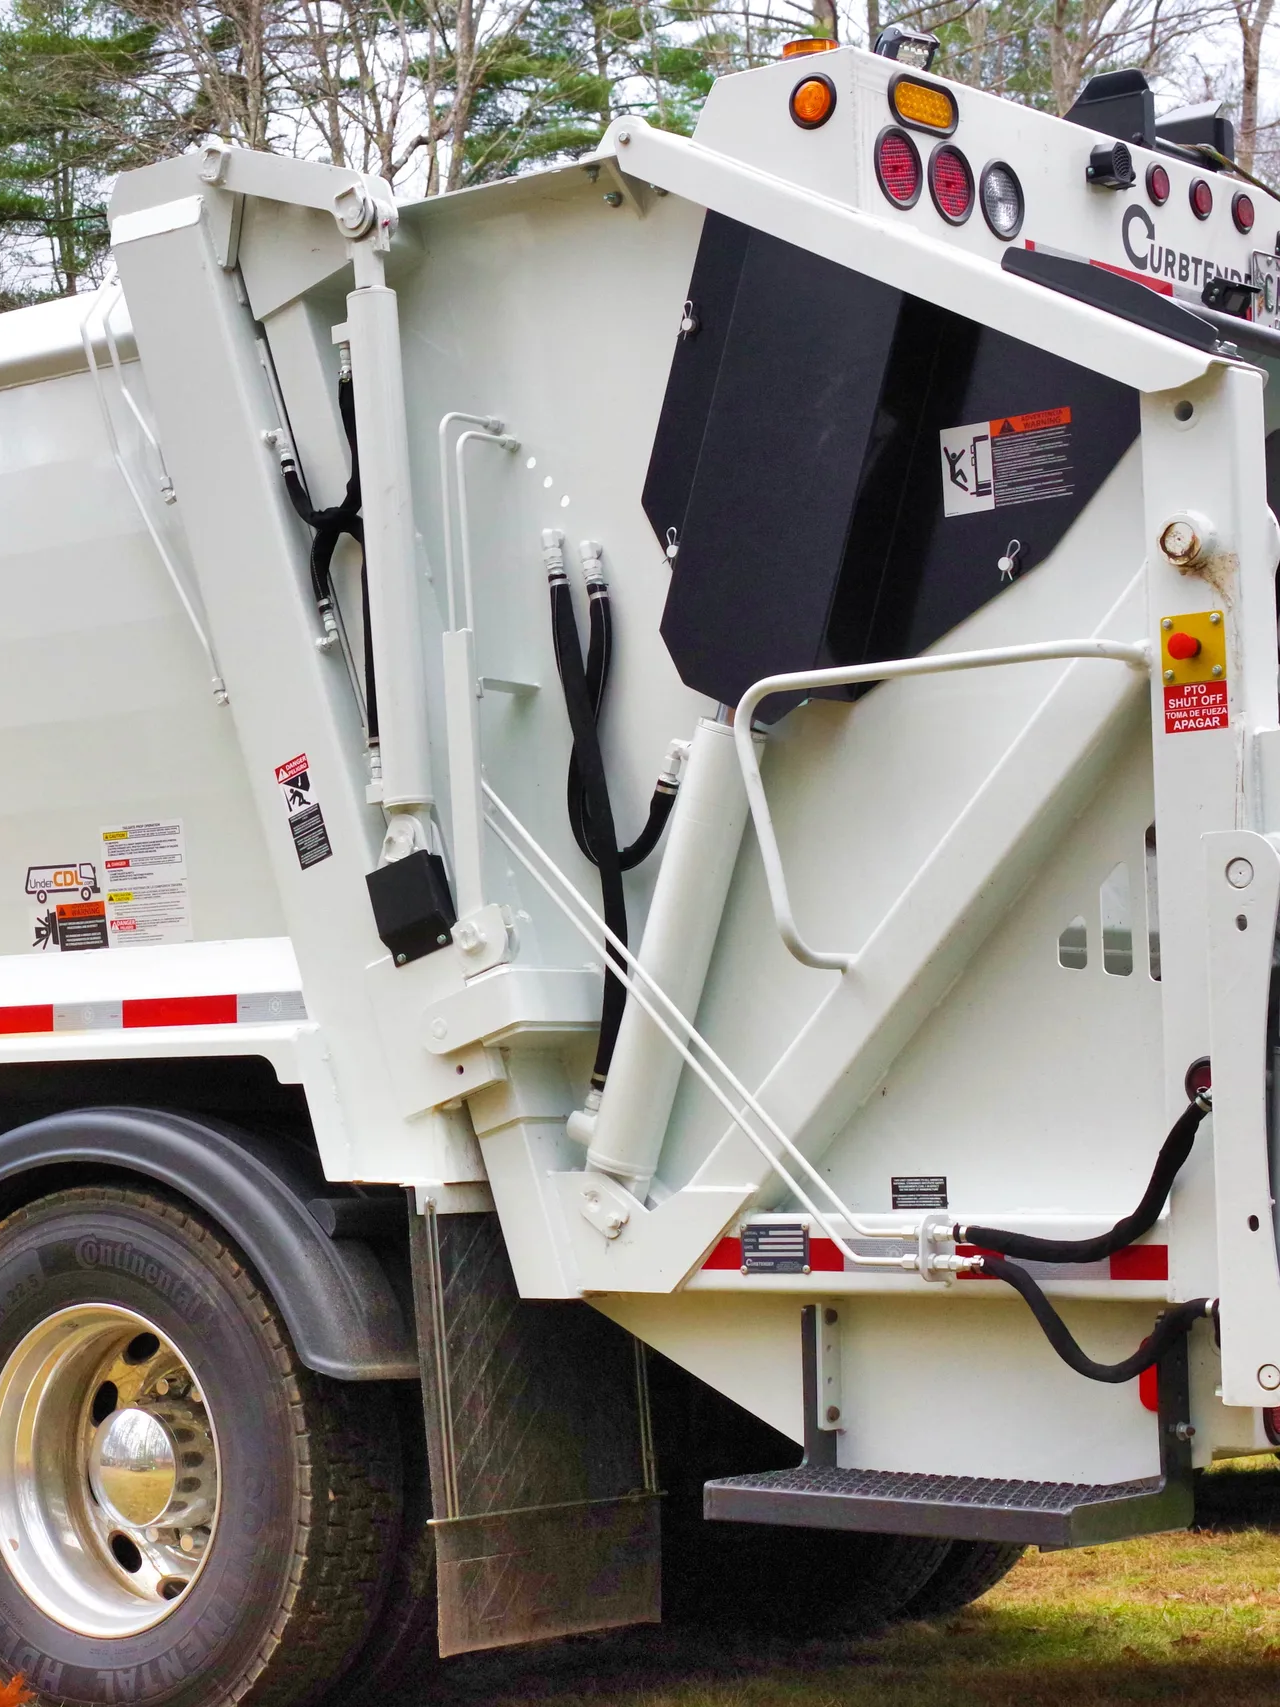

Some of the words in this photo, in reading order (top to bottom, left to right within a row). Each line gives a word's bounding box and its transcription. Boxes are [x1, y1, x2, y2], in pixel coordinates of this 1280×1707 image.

[1023, 416, 1061, 429] WARNING
[1184, 684, 1207, 696] PTO
[1168, 696, 1198, 709] SHUT
[1201, 693, 1223, 705] OFF
[1166, 711, 1188, 720] TOMA
[1189, 709, 1201, 717] DE
[1202, 707, 1228, 716] FUEZA
[1173, 716, 1220, 731] APAGAR
[285, 755, 307, 771] DANGER
[288, 762, 307, 776] PELIGRO
[72, 907, 100, 916] WARNING
[74, 1233, 200, 1317] Continental
